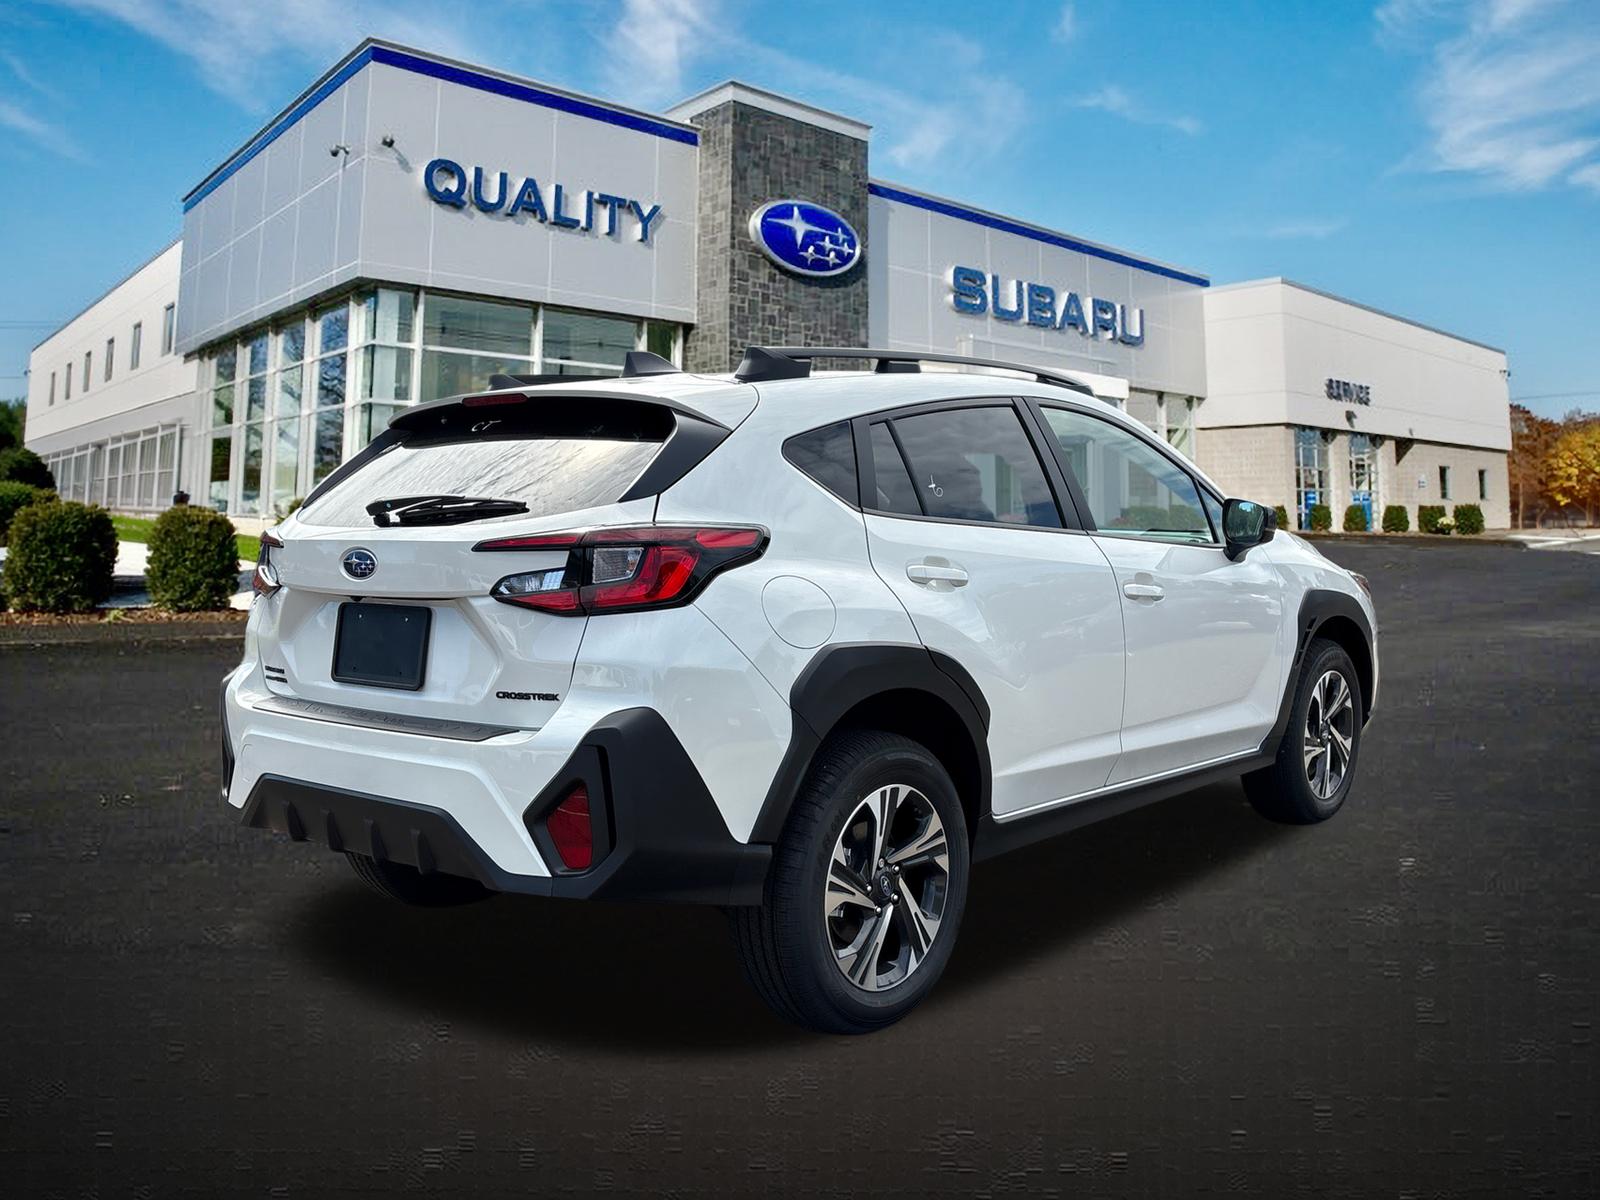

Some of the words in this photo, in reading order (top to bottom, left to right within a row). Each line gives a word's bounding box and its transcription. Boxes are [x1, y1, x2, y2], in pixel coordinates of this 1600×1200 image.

[424, 158, 662, 243] QUALITY
[947, 265, 1145, 346] SUBARU
[495, 690, 560, 702] CROSSTREK
